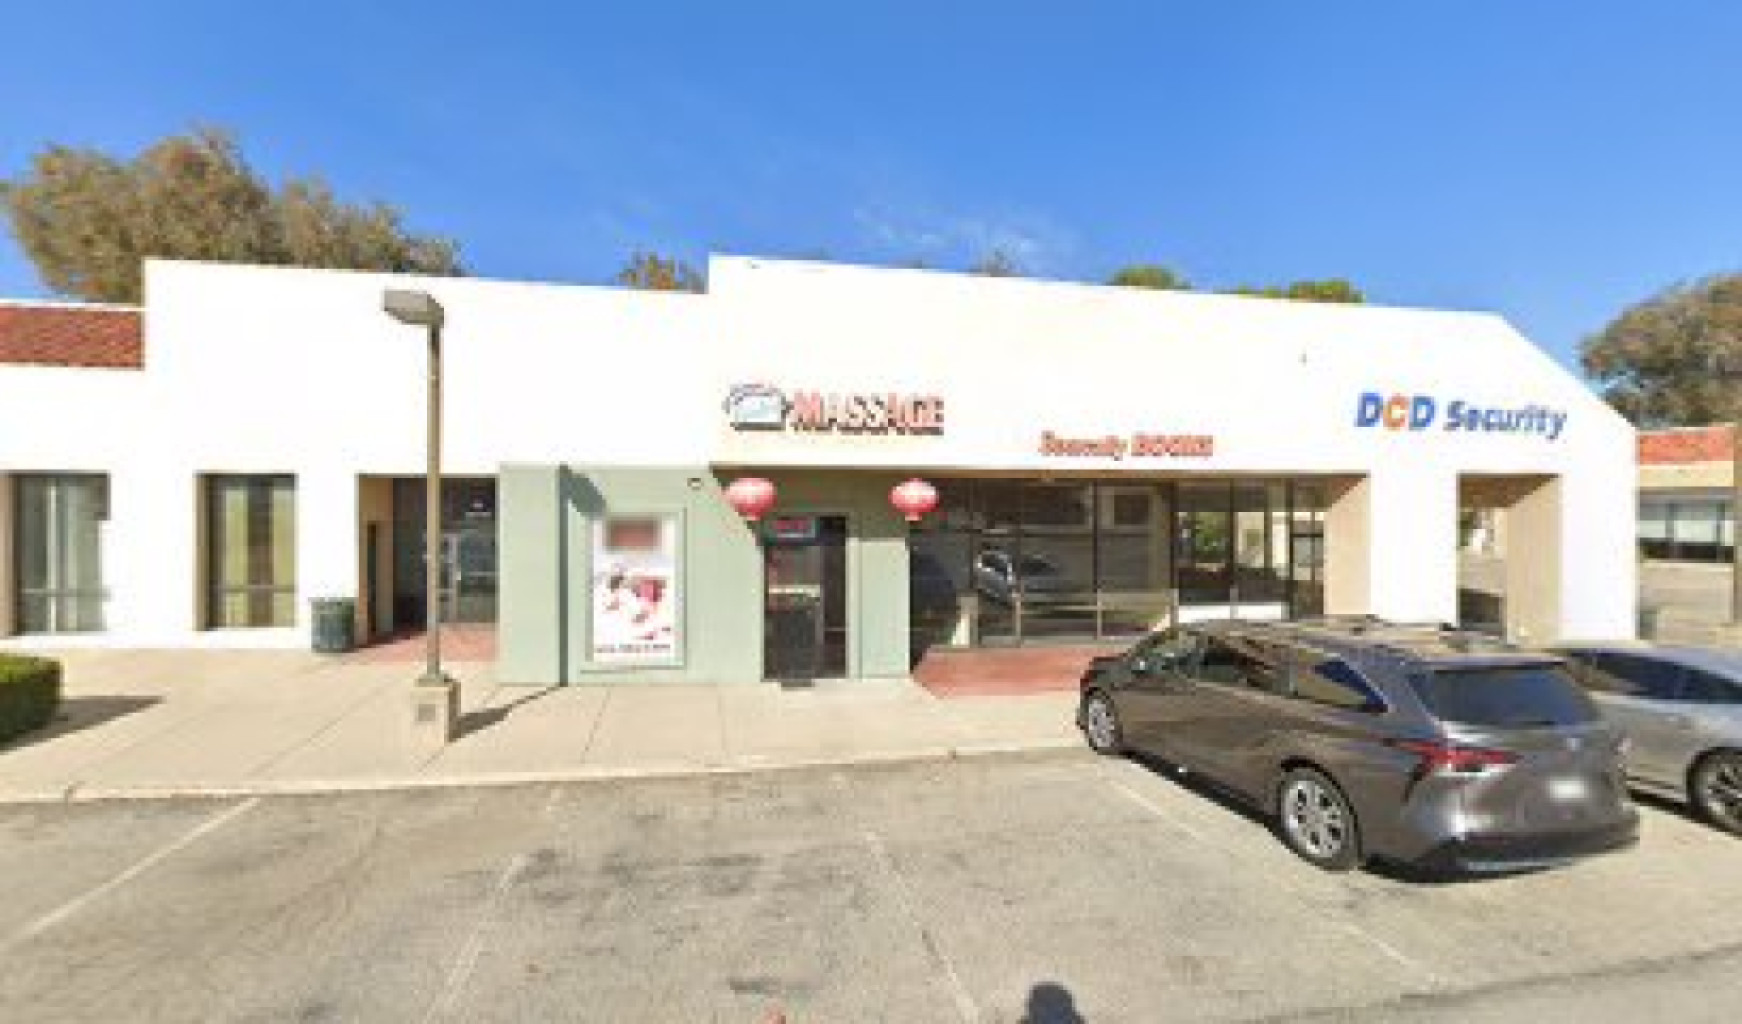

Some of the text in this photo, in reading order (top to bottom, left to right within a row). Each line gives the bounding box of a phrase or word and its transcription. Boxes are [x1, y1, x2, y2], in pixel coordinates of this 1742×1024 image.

[792, 390, 944, 434] MASSAGE
[1355, 392, 1567, 440] DCD Security
